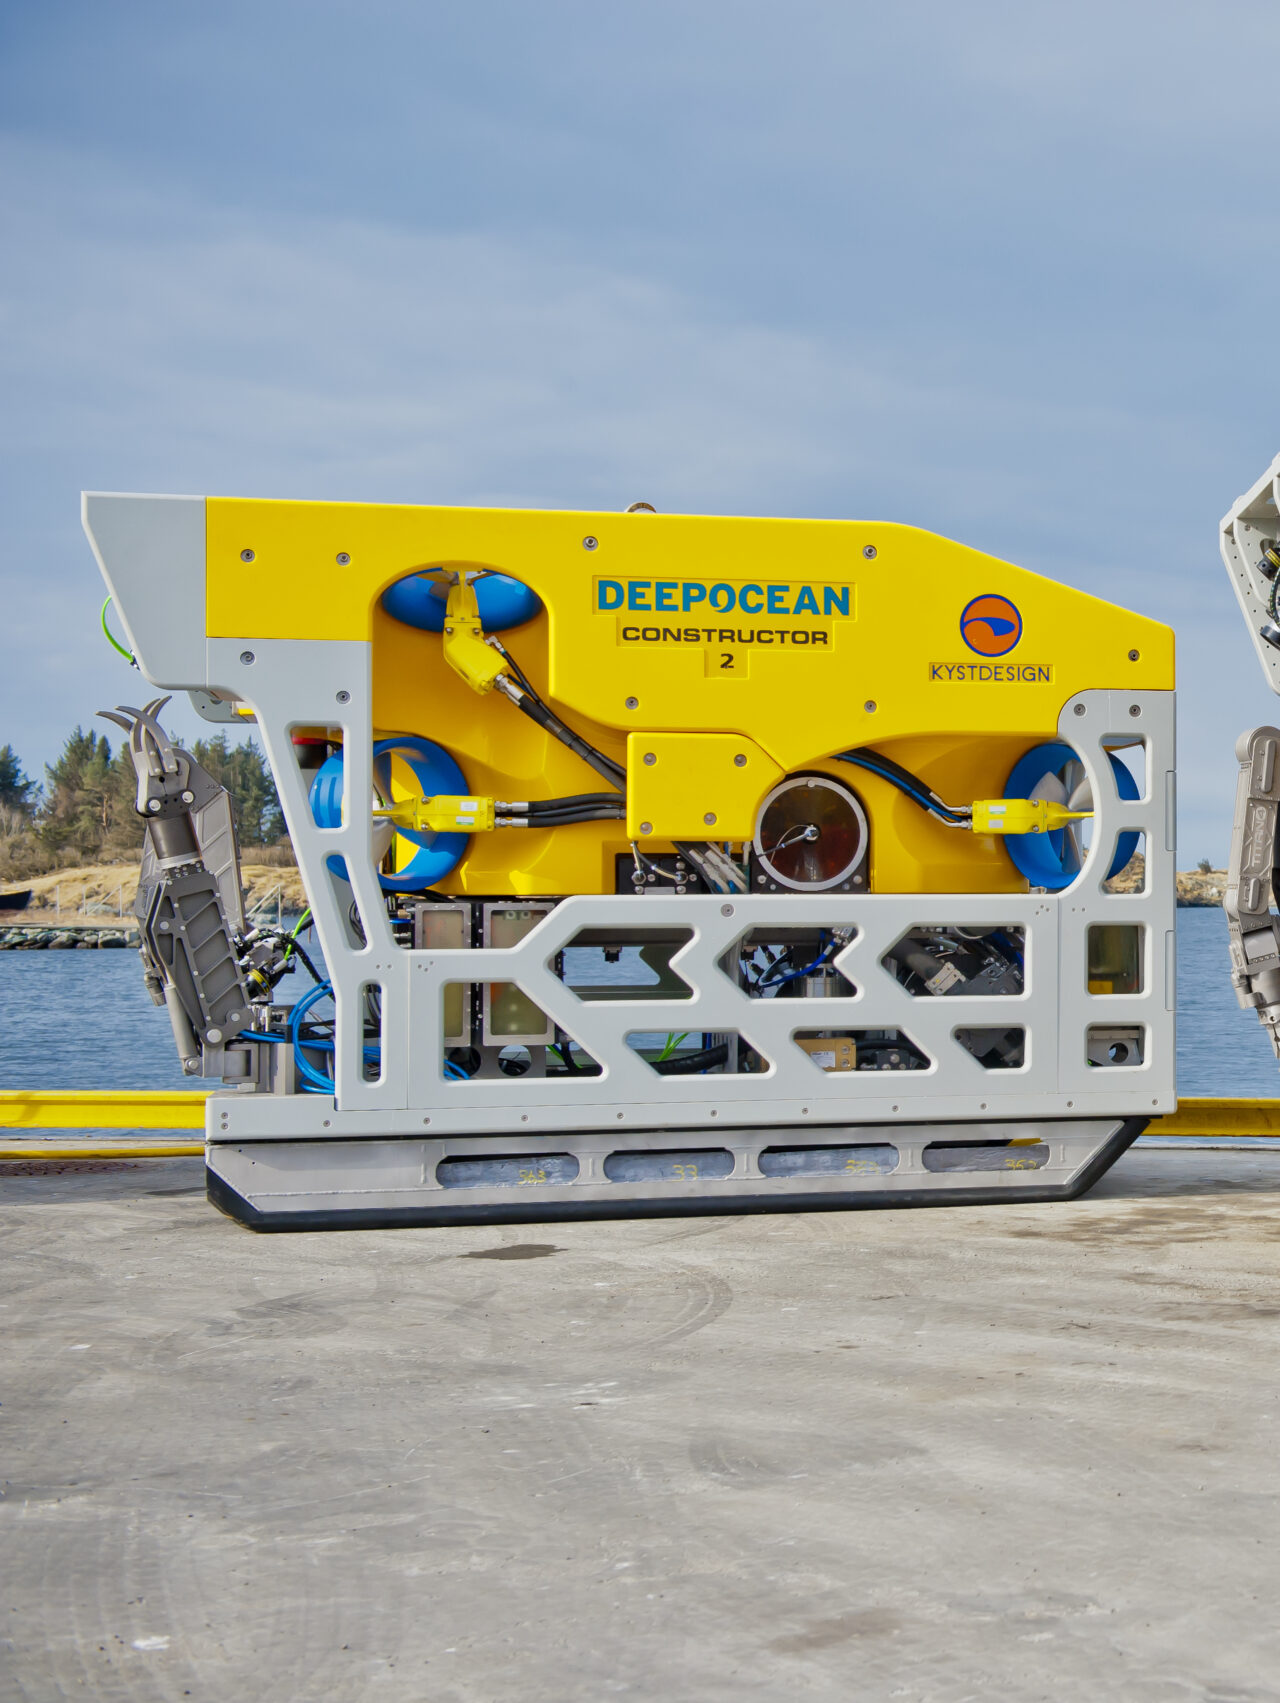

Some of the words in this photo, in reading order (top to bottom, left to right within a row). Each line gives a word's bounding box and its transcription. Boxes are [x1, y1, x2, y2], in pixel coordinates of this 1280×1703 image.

[598, 580, 850, 616] DEEPOCEAN
[622, 626, 828, 645] CONSTRUCTOR
[719, 653, 735, 669] 2
[931, 664, 1050, 682] KYSTDESIGN
